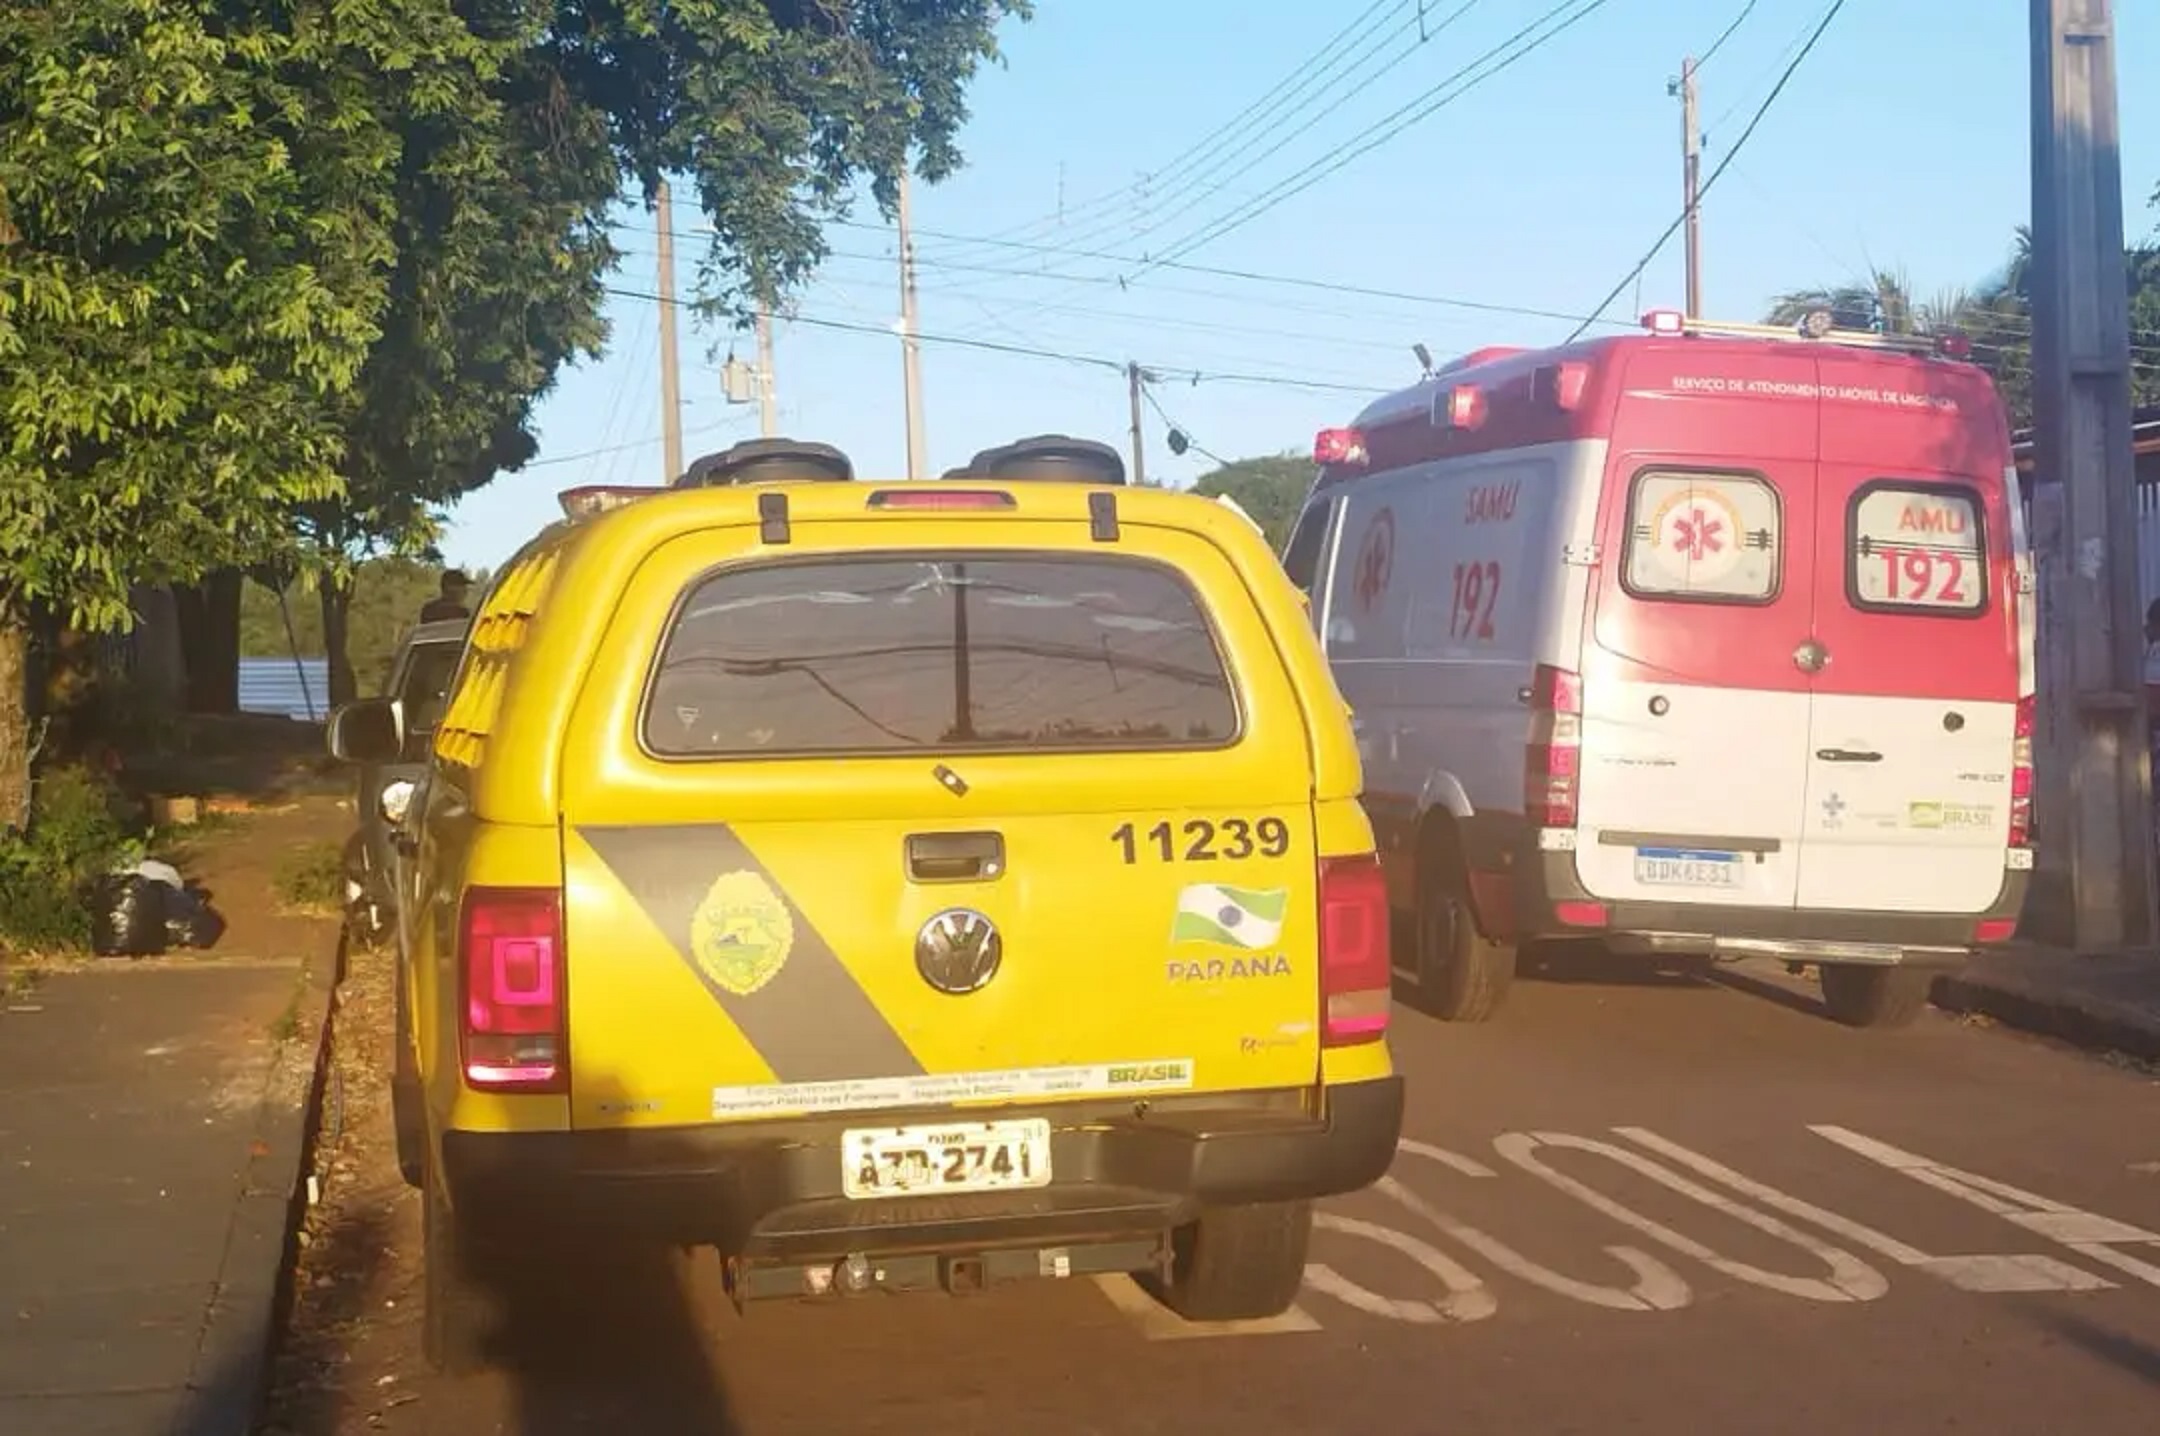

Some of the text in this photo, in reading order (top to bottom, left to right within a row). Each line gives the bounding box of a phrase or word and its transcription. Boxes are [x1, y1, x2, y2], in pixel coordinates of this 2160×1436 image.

[1728, 379, 1744, 392] DE
[1746, 381, 1836, 398] ATENDIMENTO
[1464, 478, 1520, 524] SAMU
[1880, 546, 1964, 602] 192
[1450, 560, 1501, 640] 192
[1110, 816, 1290, 865] 11239
[1107, 1064, 1188, 1084] BRASIL
